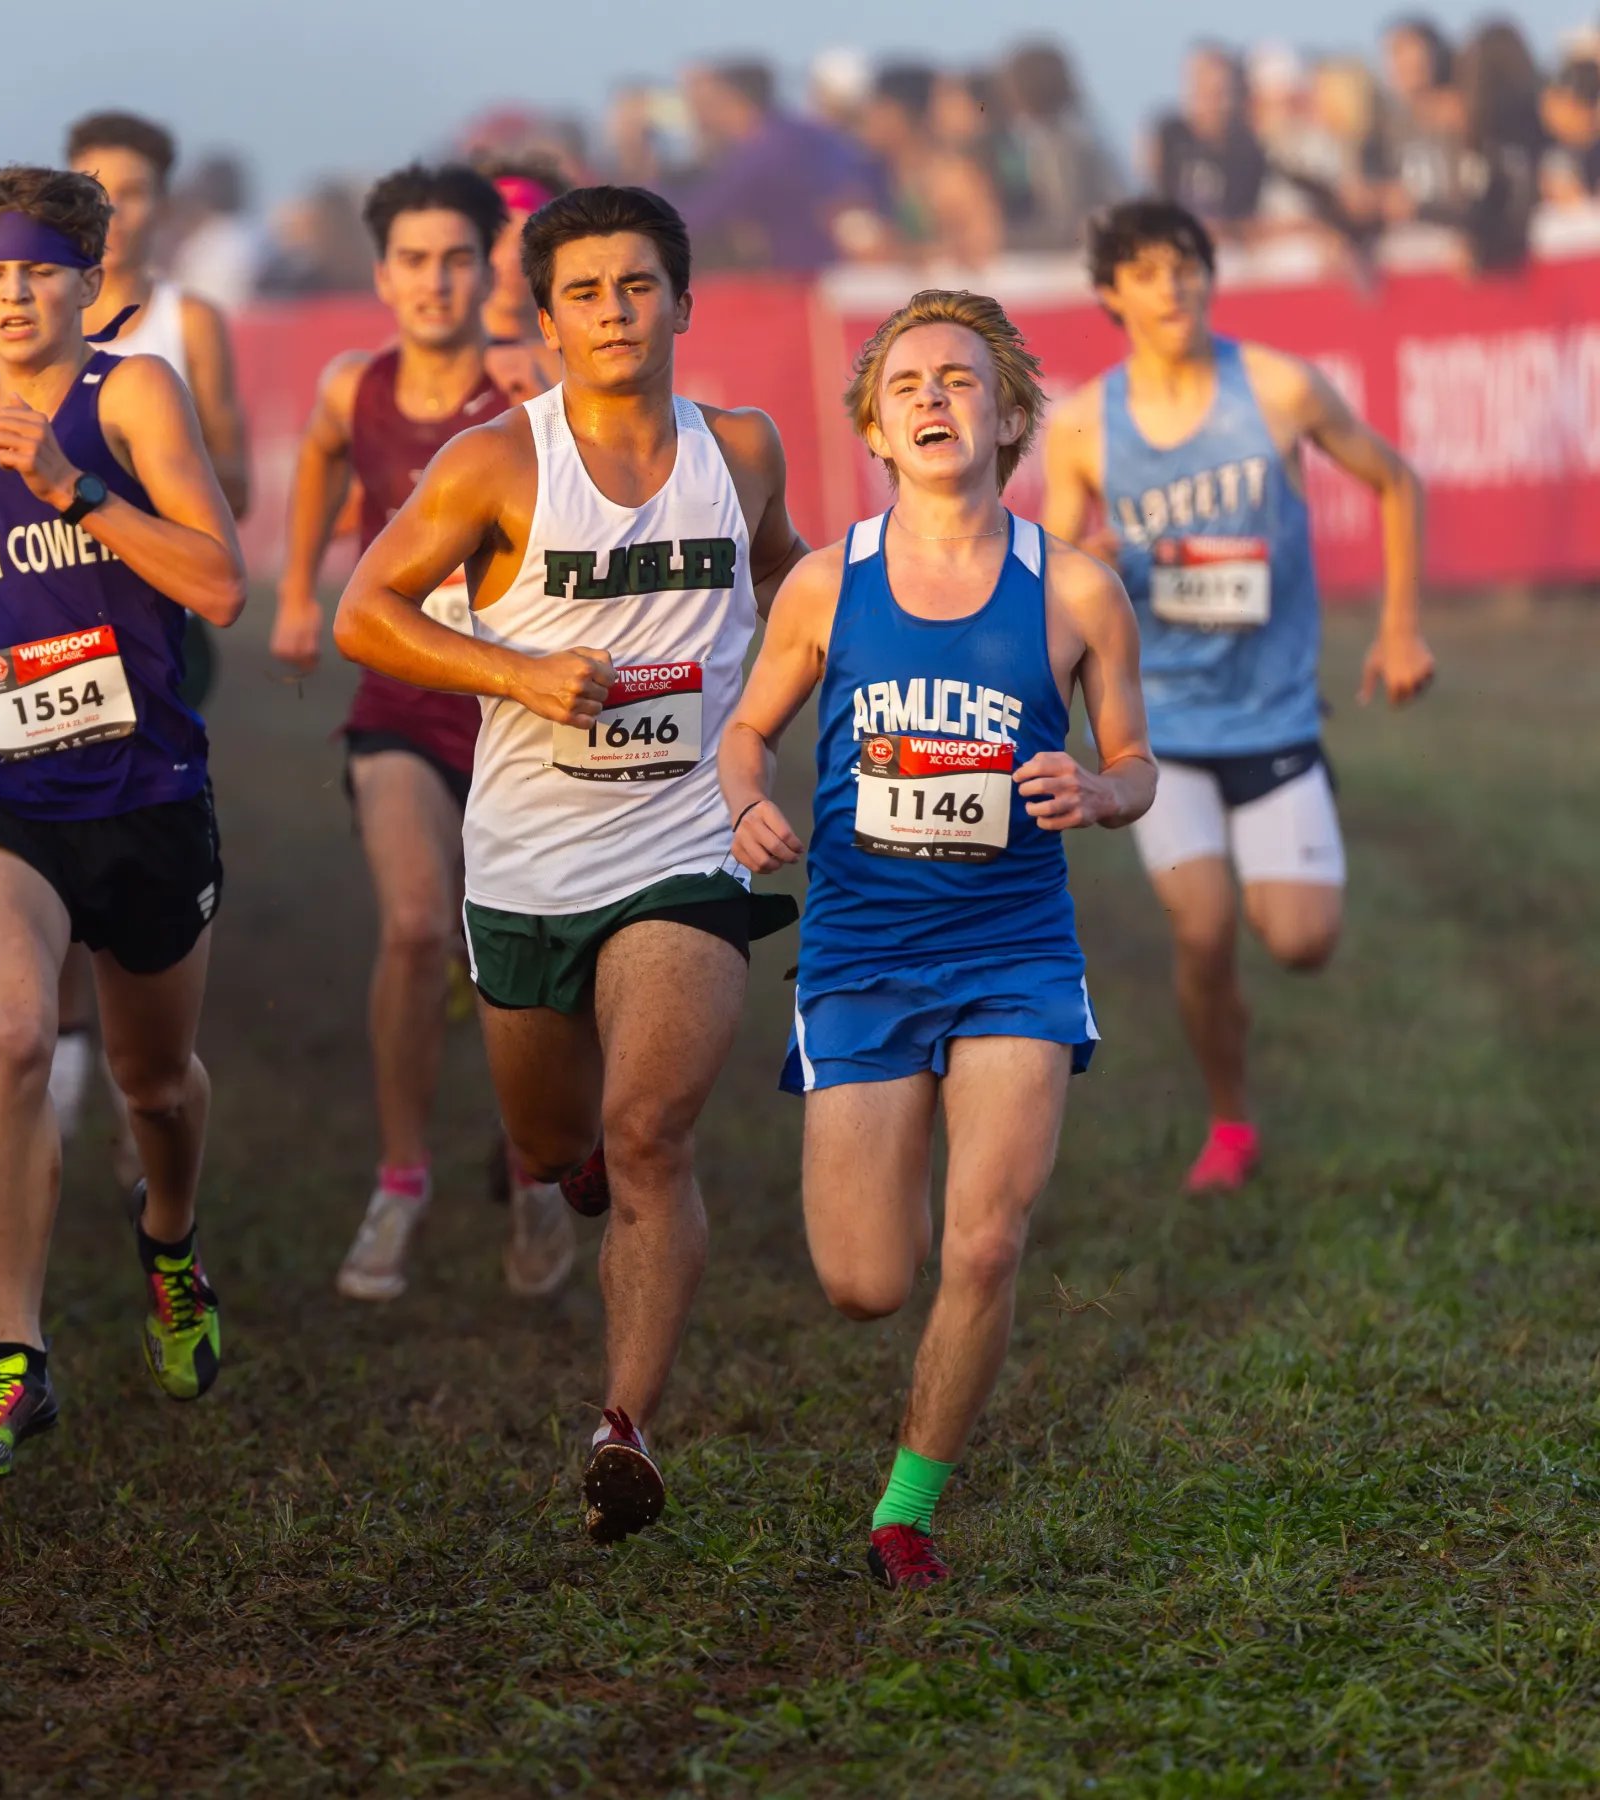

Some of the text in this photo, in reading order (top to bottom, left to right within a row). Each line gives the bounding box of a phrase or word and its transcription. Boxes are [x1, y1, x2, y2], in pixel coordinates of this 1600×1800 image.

[1116, 455, 1269, 544] LOVETT
[7, 518, 120, 574] COWE
[543, 537, 737, 600] FLAGLER
[18, 631, 101, 661] WINGFOOT
[39, 649, 86, 667] XC CLASSIC
[624, 681, 672, 693] XC CLASSIC
[12, 680, 105, 725] 1554
[853, 677, 1023, 748] ARMUCHEE
[588, 714, 679, 748] 1646
[590, 753, 623, 763] September
[641, 752, 651, 760] 23,
[653, 750, 669, 758] 2023
[875, 746, 887, 755] XC
[910, 739, 1000, 757] WINGFOOT
[929, 755, 980, 767] XC CLASSIC
[888, 786, 984, 825] 1146
[890, 825, 923, 835] September
